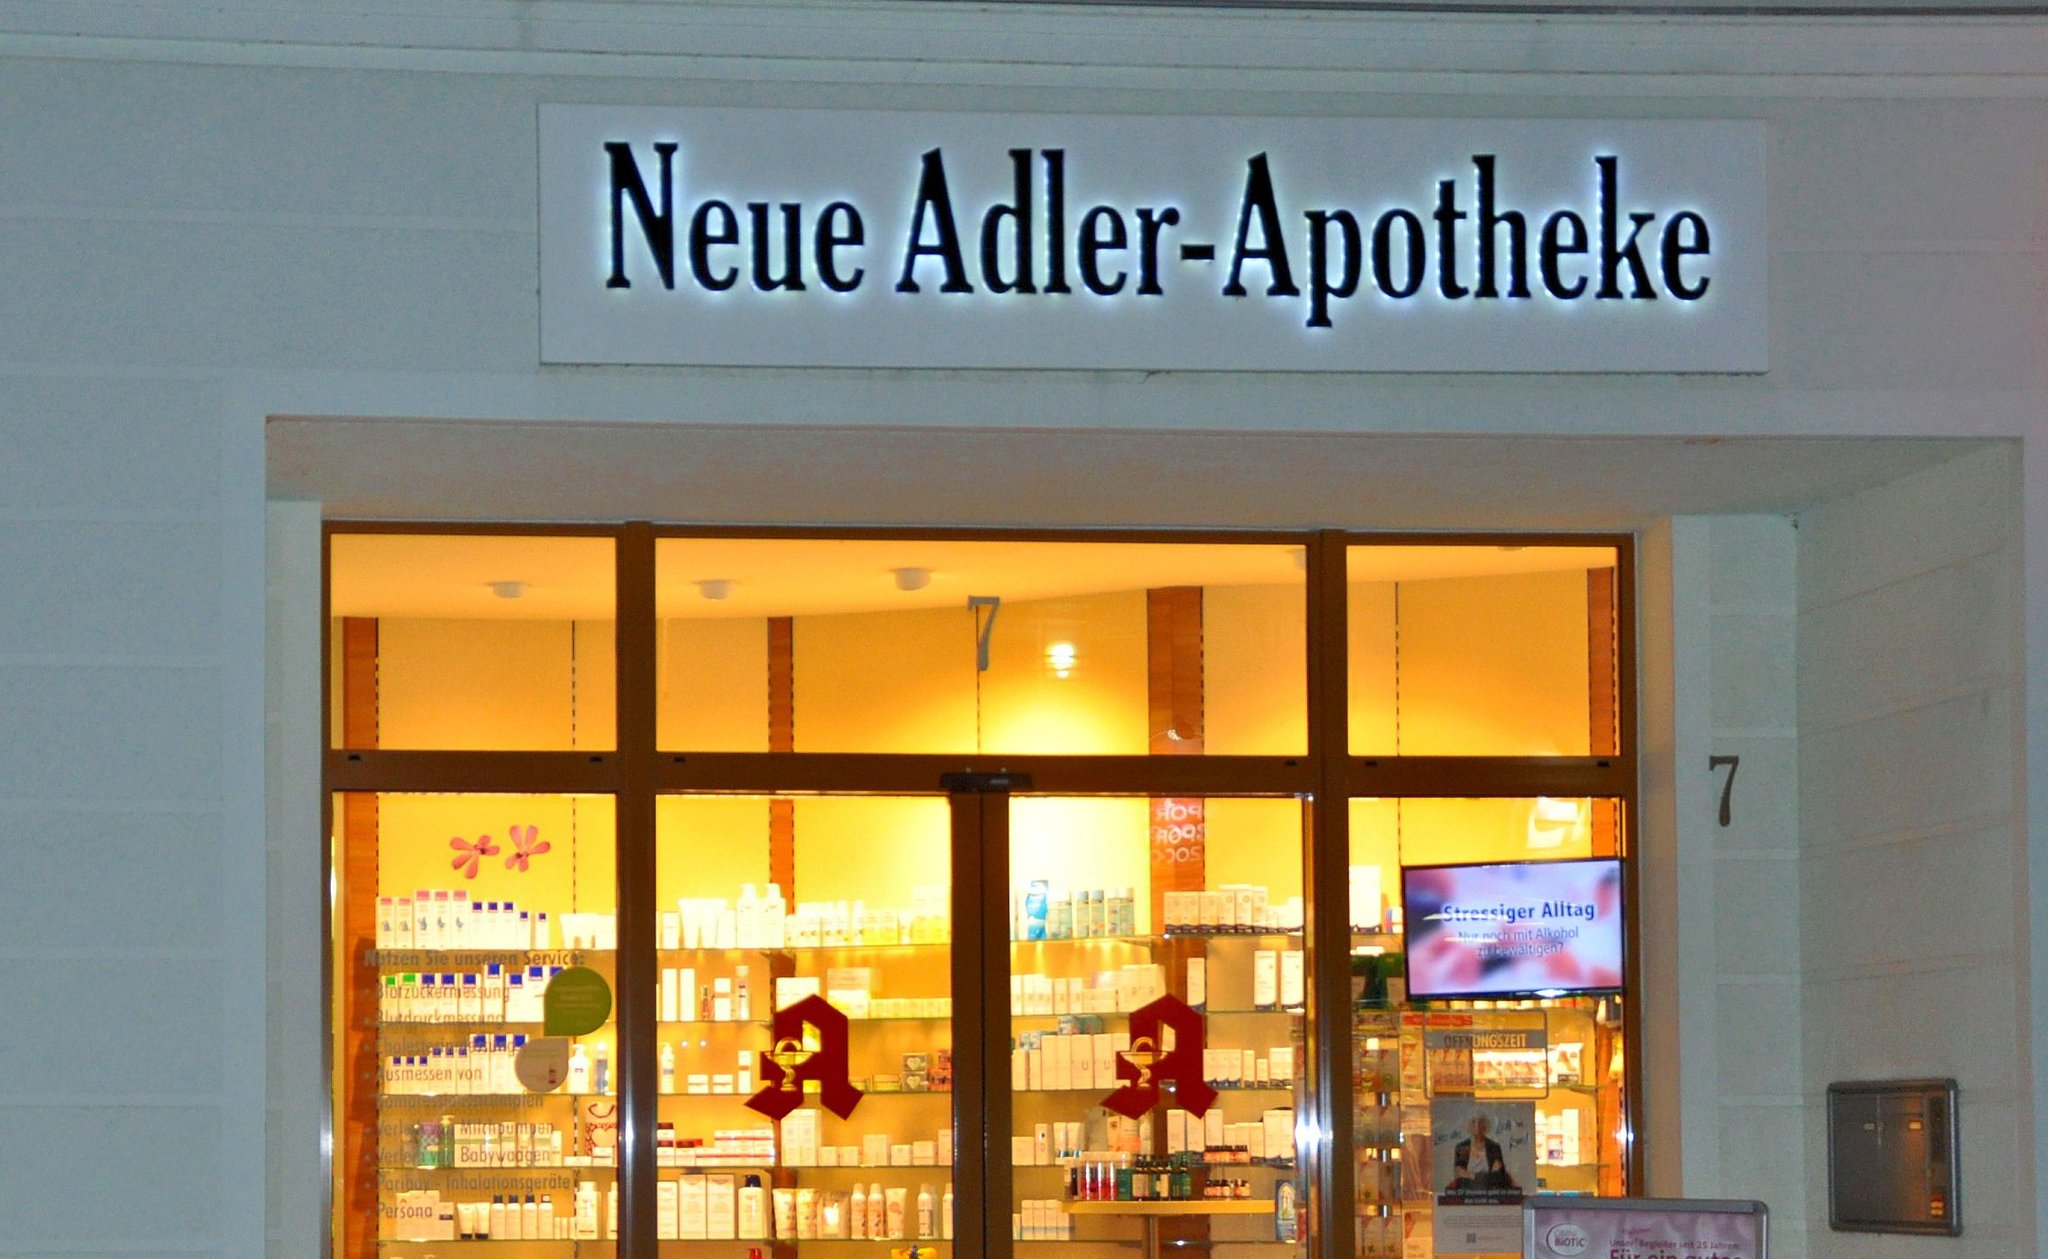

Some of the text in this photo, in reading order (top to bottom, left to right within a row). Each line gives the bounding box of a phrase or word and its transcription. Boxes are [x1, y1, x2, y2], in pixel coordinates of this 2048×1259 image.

[604, 142, 1711, 328] Neue Adler-Apotheke
[967, 595, 1000, 671] 7
[1709, 755, 1740, 827] 7
[1443, 901, 1595, 923] Stressiger Alltag
[1513, 927, 1533, 940] mit
[1535, 926, 1579, 940] Alkohol
[425, 950, 450, 966] Sie
[455, 951, 520, 966] unseren
[524, 949, 585, 966] Service:
[458, 1069, 482, 1081] von
[446, 1174, 571, 1193] Inhalationsgeräte
[378, 1202, 433, 1218] Persona
